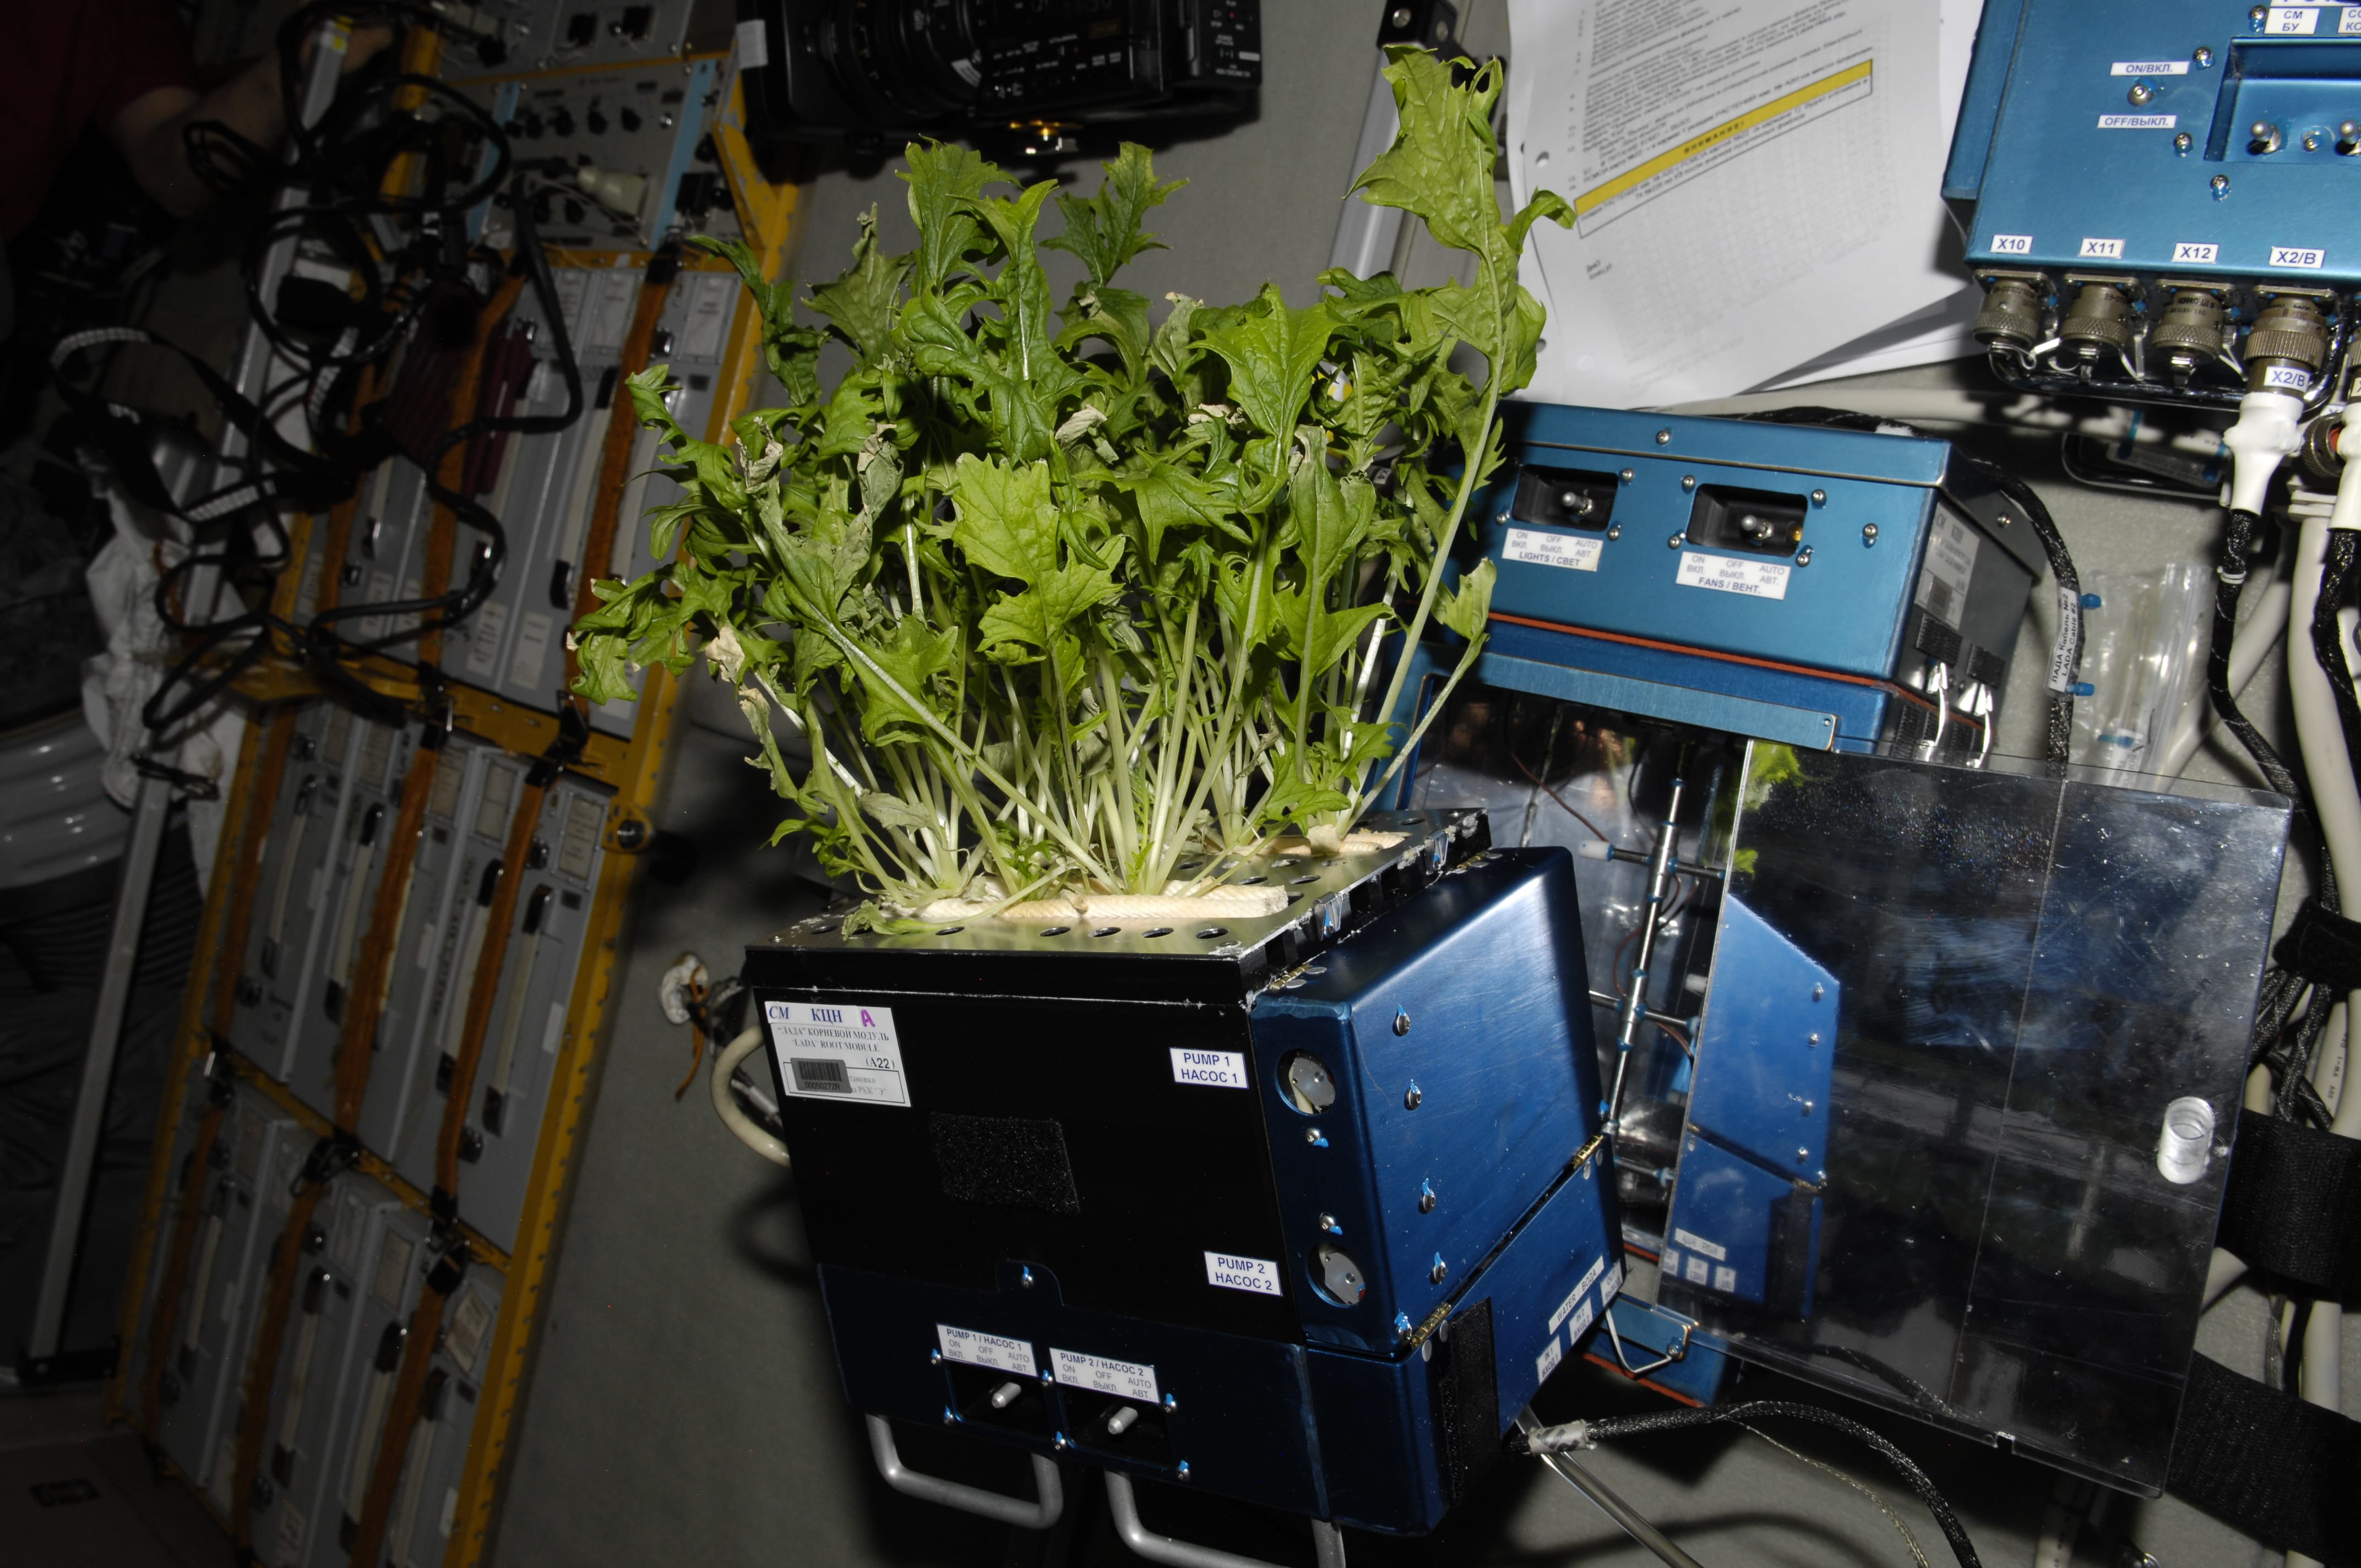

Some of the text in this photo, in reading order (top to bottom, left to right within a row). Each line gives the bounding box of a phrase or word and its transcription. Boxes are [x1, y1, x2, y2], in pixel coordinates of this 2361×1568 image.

[2284, 10, 2303, 19] СМ
[2282, 23, 2299, 31] БУ
[2125, 64, 2173, 73] ON/ВКЛ.
[2104, 117, 2168, 126] OFF/ВЫКЛ.
[1511, 540, 1527, 549] ВКЛ.
[1546, 535, 1563, 544] OFF
[1575, 539, 1598, 549] AUTO
[1519, 552, 1550, 563] LIGHTS
[1557, 557, 1581, 567] СВЕТ
[1691, 554, 1785, 575] ON OFF AUTO
[1687, 564, 1705, 574] ВКЛ.
[1698, 577, 1724, 588] FANS
[1732, 582, 1761, 594] ВЕНТ.
[2061, 602, 2077, 677] LADA Cable #2
[2052, 654, 2063, 683] ЛАДА
[2059, 614, 2069, 650] Кабель
[769, 1006, 843, 1025] СМ КЦН
[808, 1028, 852, 1038] КОРНЕВОЙ
[853, 1030, 890, 1041] МОДУЛЬ
[820, 1040, 843, 1050] ROOT
[845, 1042, 881, 1053] MODULE
[1183, 1053, 1230, 1066] PUMP 1
[1181, 1068, 1238, 1084] НАСОС 1
[1218, 1257, 1265, 1274] PUMP 2
[1215, 1272, 1273, 1291] НАСОС 2
[1557, 1268, 1597, 1322] WATER ВОДА
[1576, 1312, 1582, 1322] IN
[1574, 1319, 1587, 1339] ВХОД
[946, 1329, 970, 1339] PUMP
[983, 1336, 1015, 1349] НАСОС
[949, 1339, 1030, 1363] ON OFF AUTO
[1544, 1351, 1551, 1362] IN
[1060, 1352, 1086, 1364] PUMP
[1088, 1358, 1095, 1366] 2
[1101, 1360, 1136, 1374] НАСОС
[1138, 1368, 1144, 1376] 2
[1542, 1358, 1556, 1378] ВХОД
[1063, 1364, 1152, 1389] ON OFF AUTO
[1093, 1380, 1120, 1393] ВЫКЛ.
[1133, 1389, 1152, 1400] АВТ.
